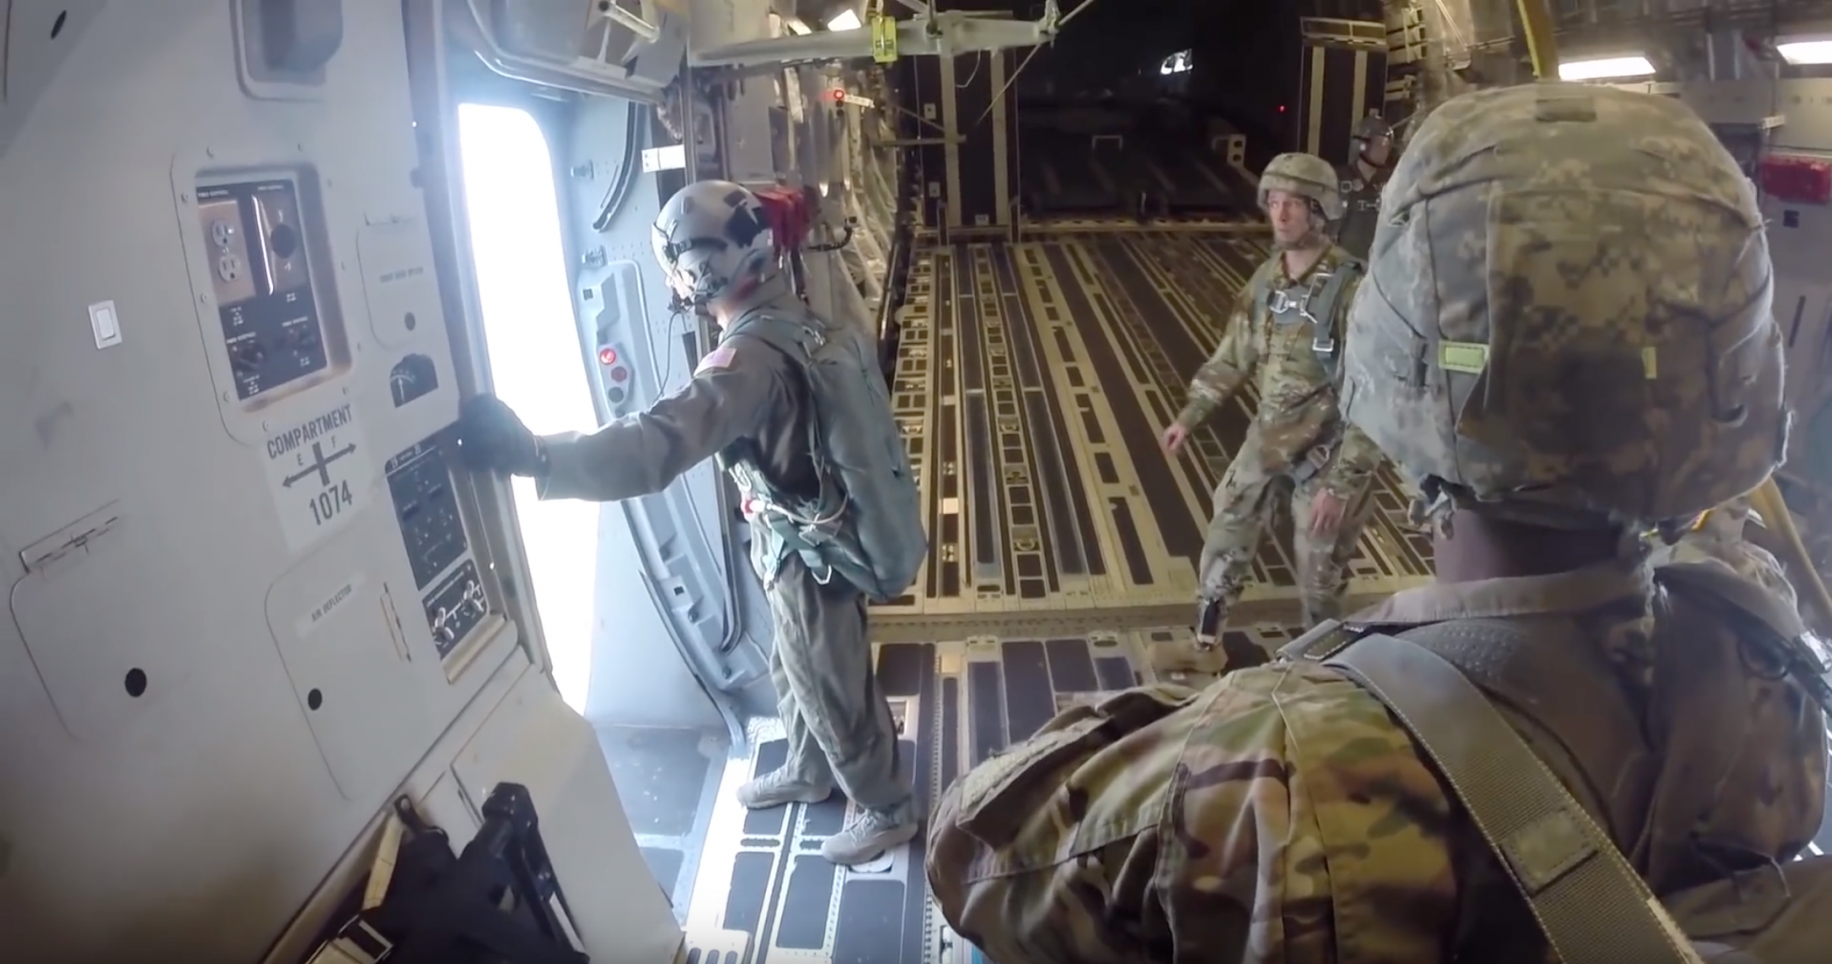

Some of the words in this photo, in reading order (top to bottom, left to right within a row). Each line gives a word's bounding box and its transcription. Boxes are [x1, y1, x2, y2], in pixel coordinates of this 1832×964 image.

[267, 403, 352, 460] COMPARTMENT
[296, 453, 304, 467] E
[331, 435, 336, 449] F
[309, 479, 353, 526] 1074
